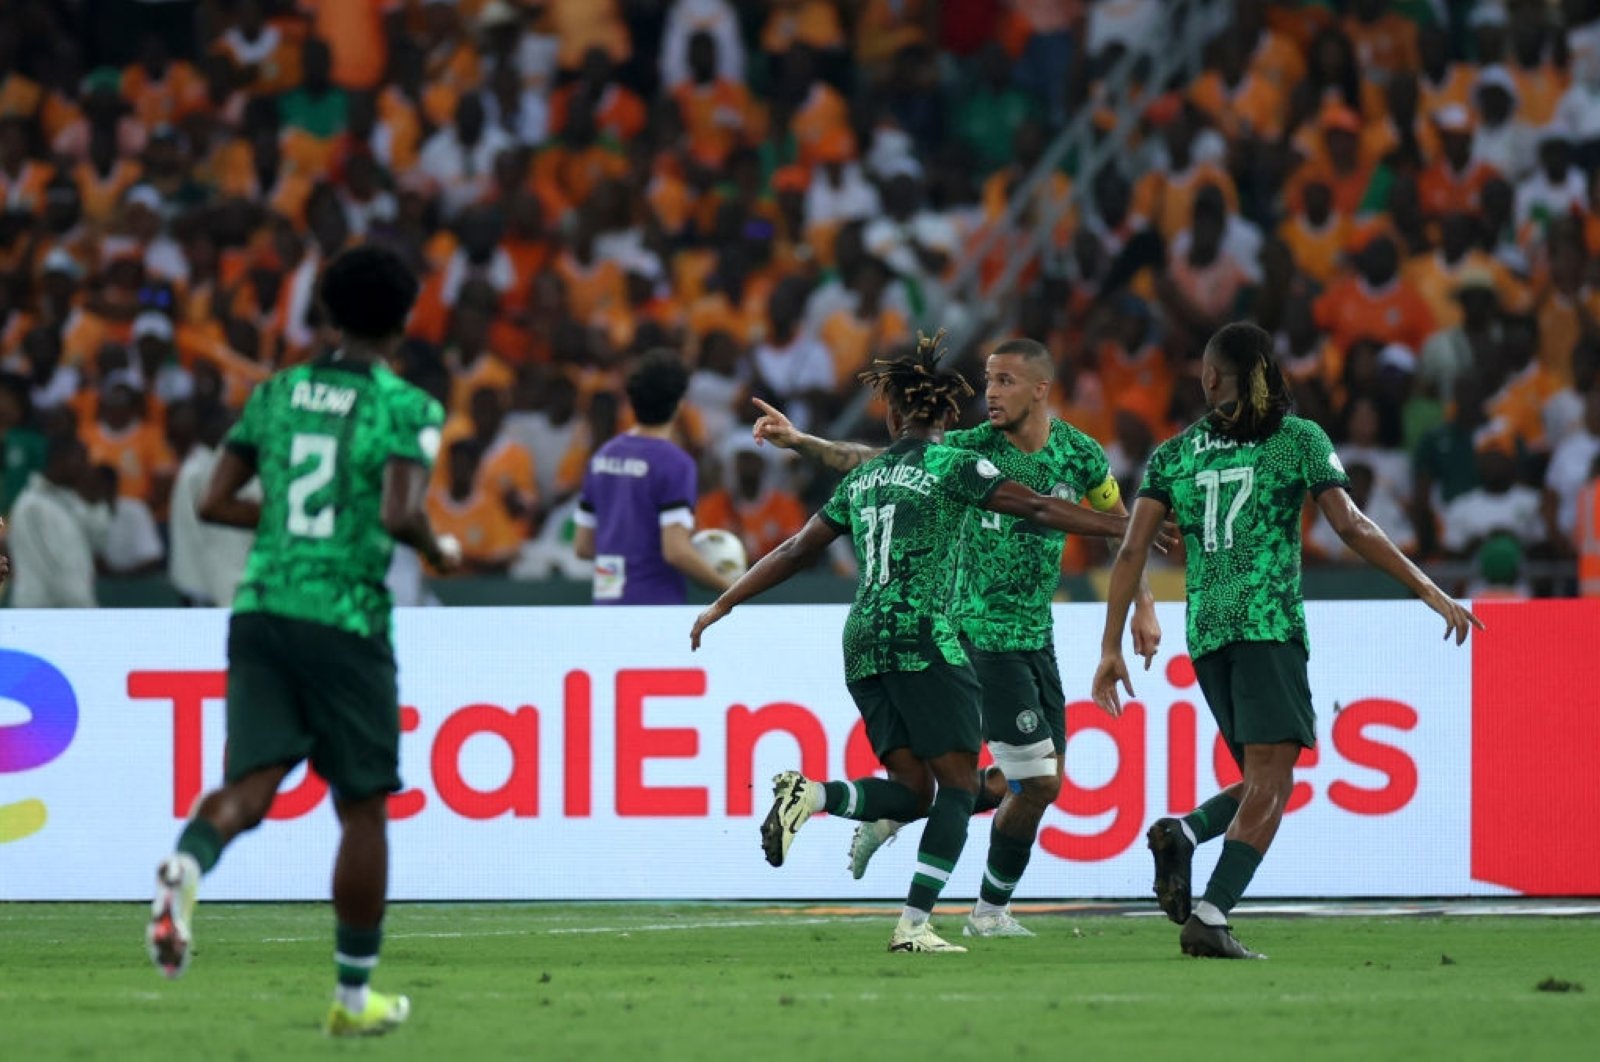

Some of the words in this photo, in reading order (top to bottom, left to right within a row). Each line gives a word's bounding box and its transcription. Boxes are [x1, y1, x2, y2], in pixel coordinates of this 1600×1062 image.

[287, 433, 337, 538] 2
[1195, 466, 1254, 552] 17
[860, 504, 896, 587] 11
[127, 654, 1418, 862] TalEngis
